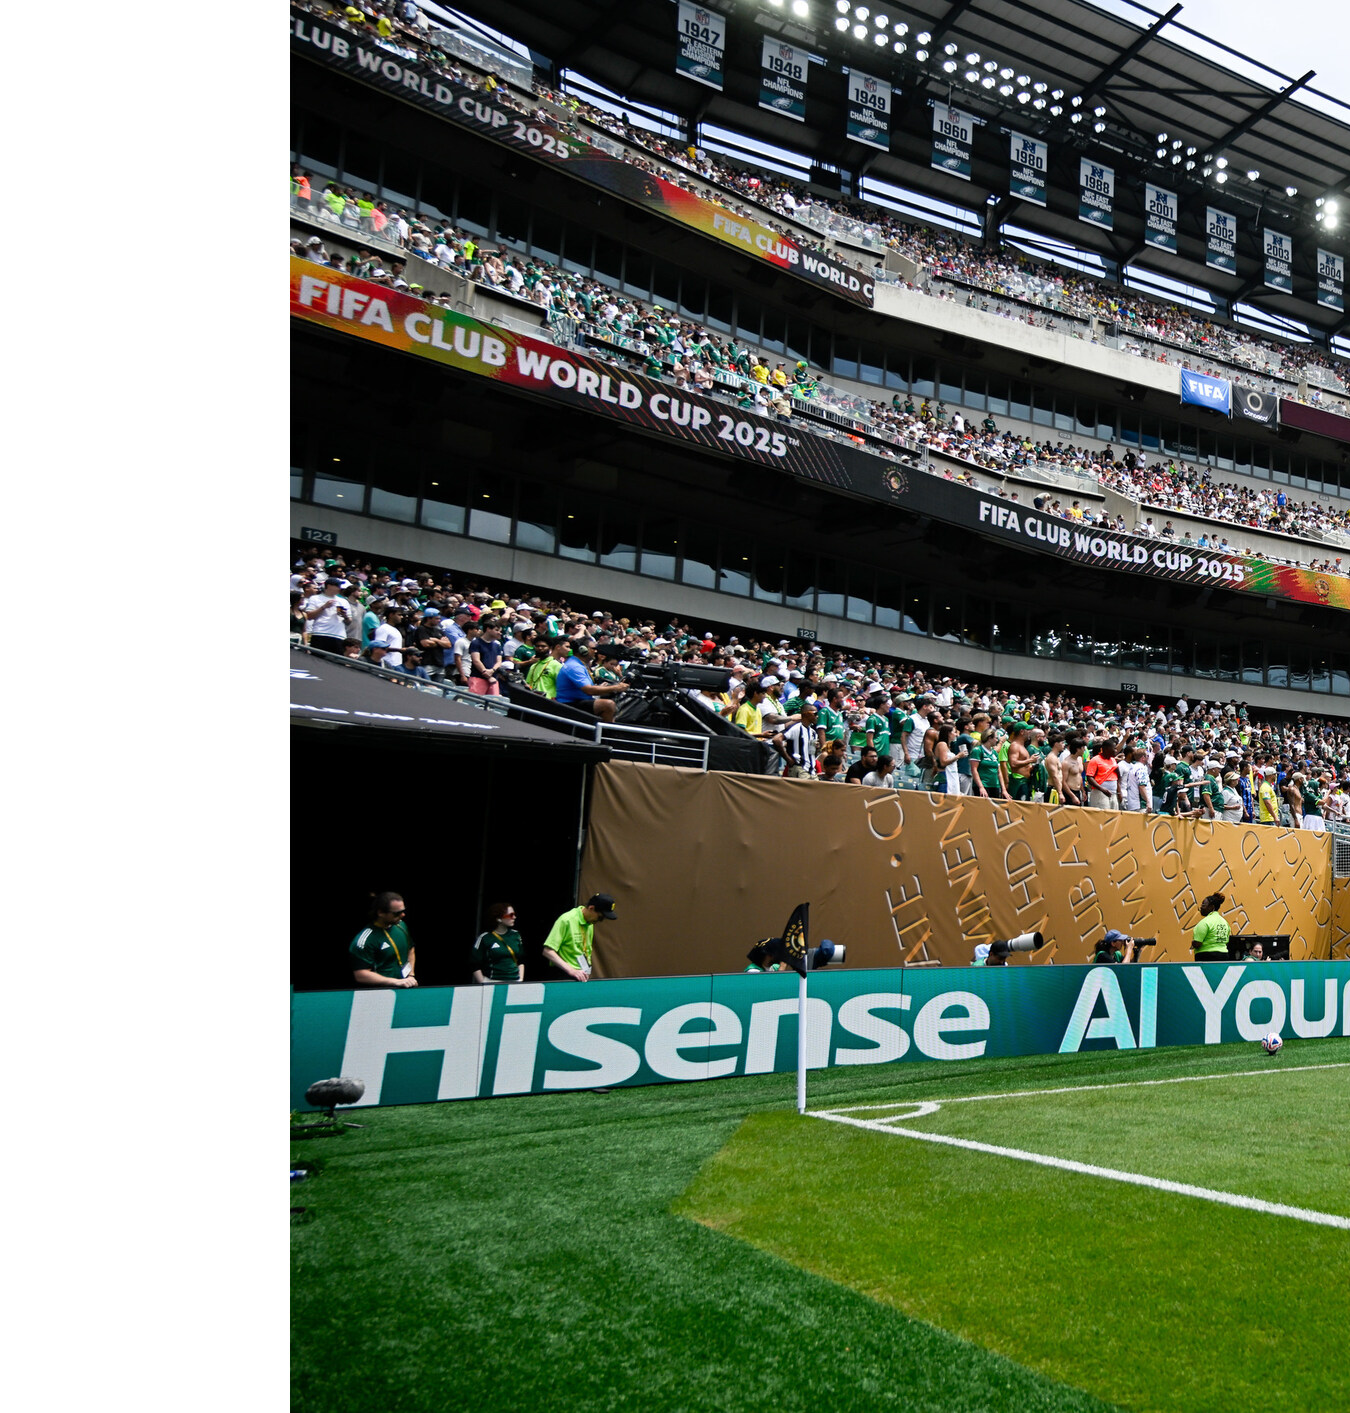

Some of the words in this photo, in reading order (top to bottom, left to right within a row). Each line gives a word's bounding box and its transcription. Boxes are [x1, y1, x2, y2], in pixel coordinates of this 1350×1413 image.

[684, 19, 720, 45] 1947
[681, 49, 720, 71] CHAMPIONS
[768, 55, 802, 79] 1948
[290, 17, 349, 58] LUB
[357, 47, 453, 104] WORLD
[459, 97, 508, 128] CUP
[777, 76, 790, 88] NFL
[763, 78, 804, 100] CHAMPIONS
[854, 87, 886, 111] 1949
[850, 110, 888, 130] CHAMPIONS
[862, 108, 875, 118] NFL
[938, 119, 968, 141] 1960
[934, 141, 970, 161] CHAMPIONS
[1015, 149, 1043, 170] 1980
[1084, 174, 1110, 194] 1988
[1149, 200, 1173, 218] 2001
[1209, 222, 1234, 241] 2002
[713, 213, 752, 244] FIFA
[756, 234, 799, 264] CLUB
[802, 253, 860, 292] WORLD
[1266, 244, 1290, 261] 2003
[1319, 262, 1341, 280] 2004
[299, 274, 394, 333] FIFA
[404, 312, 506, 367] CLUB
[516, 345, 643, 410] WORLD
[650, 394, 711, 430] CUP
[1188, 379, 1225, 401] FIFA
[305, 530, 333, 543] 124
[979, 500, 1021, 533] FIFA
[1024, 517, 1070, 547] CLUB
[1074, 532, 1148, 565] WORLD
[1153, 549, 1193, 572] CUP
[800, 630, 815, 639] 123
[339, 982, 991, 1106] Hisense
[1058, 966, 1158, 1053] AI
